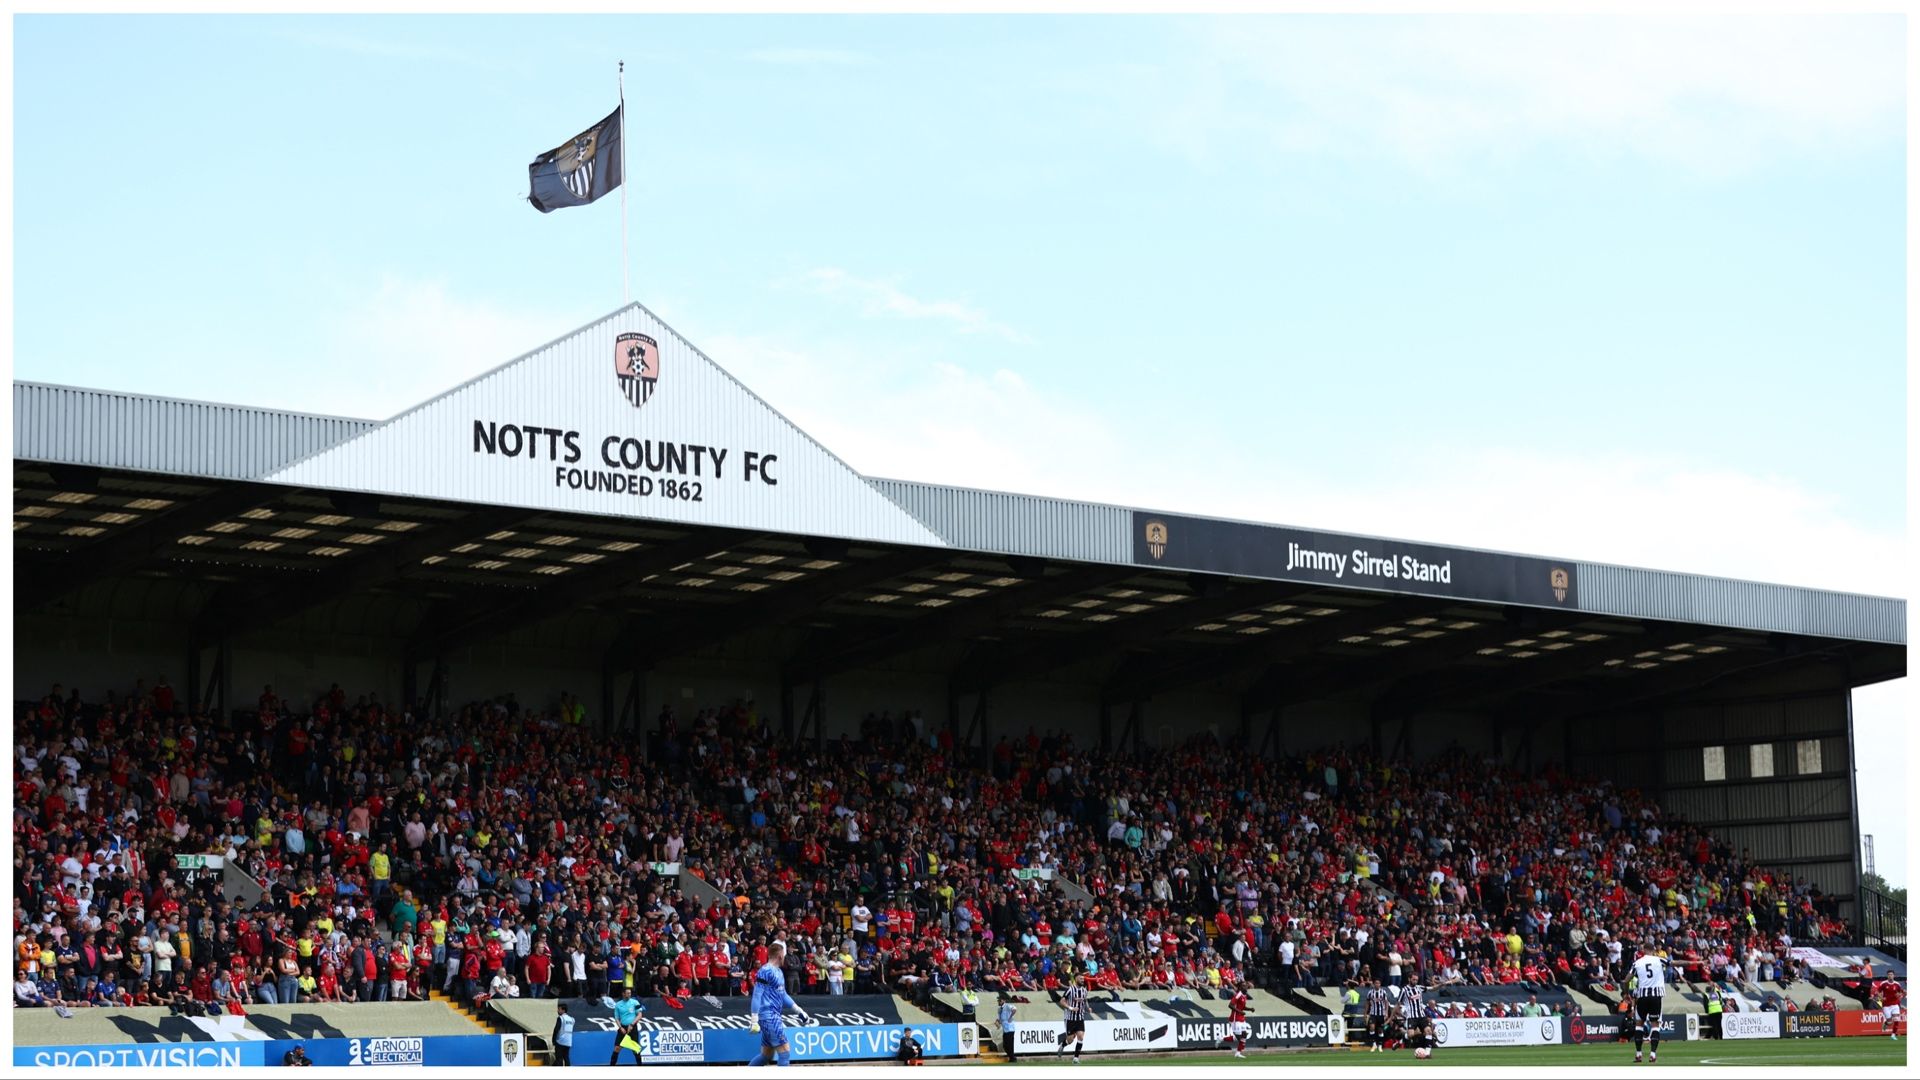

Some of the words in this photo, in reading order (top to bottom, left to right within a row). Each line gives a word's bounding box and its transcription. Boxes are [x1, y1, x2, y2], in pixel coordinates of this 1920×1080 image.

[473, 420, 581, 463] NOTTS
[601, 435, 727, 479] COUNTY
[744, 451, 778, 485] FC
[556, 466, 653, 496] FOUNDED
[657, 478, 703, 502] 1862
[1286, 542, 1347, 578] Jimmy
[1352, 549, 1398, 578] Sirrel
[1401, 555, 1451, 584] Stand
[1645, 963, 1653, 978] 5
[1740, 1017, 1762, 1025] DENNIS
[1800, 1015, 1830, 1024] HAINES
[1861, 1012, 1878, 1023] John
[1465, 1021, 1490, 1031] SPORTS
[1492, 1021, 1524, 1030] GATEWAY
[1786, 1015, 1799, 1032] HGL
[1113, 1027, 1146, 1041] CARLING
[1178, 1022, 1212, 1042] JAKE
[1213, 1022, 1252, 1041] BUG
[1256, 1021, 1289, 1040] JAKE
[1290, 1021, 1327, 1039] BUGG
[1586, 1024, 1598, 1035] Bar
[1598, 1024, 1619, 1034] Alarm
[1740, 1025, 1775, 1034] ELECTRICAL
[661, 1032, 702, 1043] ARNOLD
[1020, 1030, 1055, 1044] CARLING
[374, 1040, 421, 1052] ARNOLD
[661, 1044, 702, 1054] ELECTRICAL
[373, 1052, 421, 1062] ELECTRICAL
